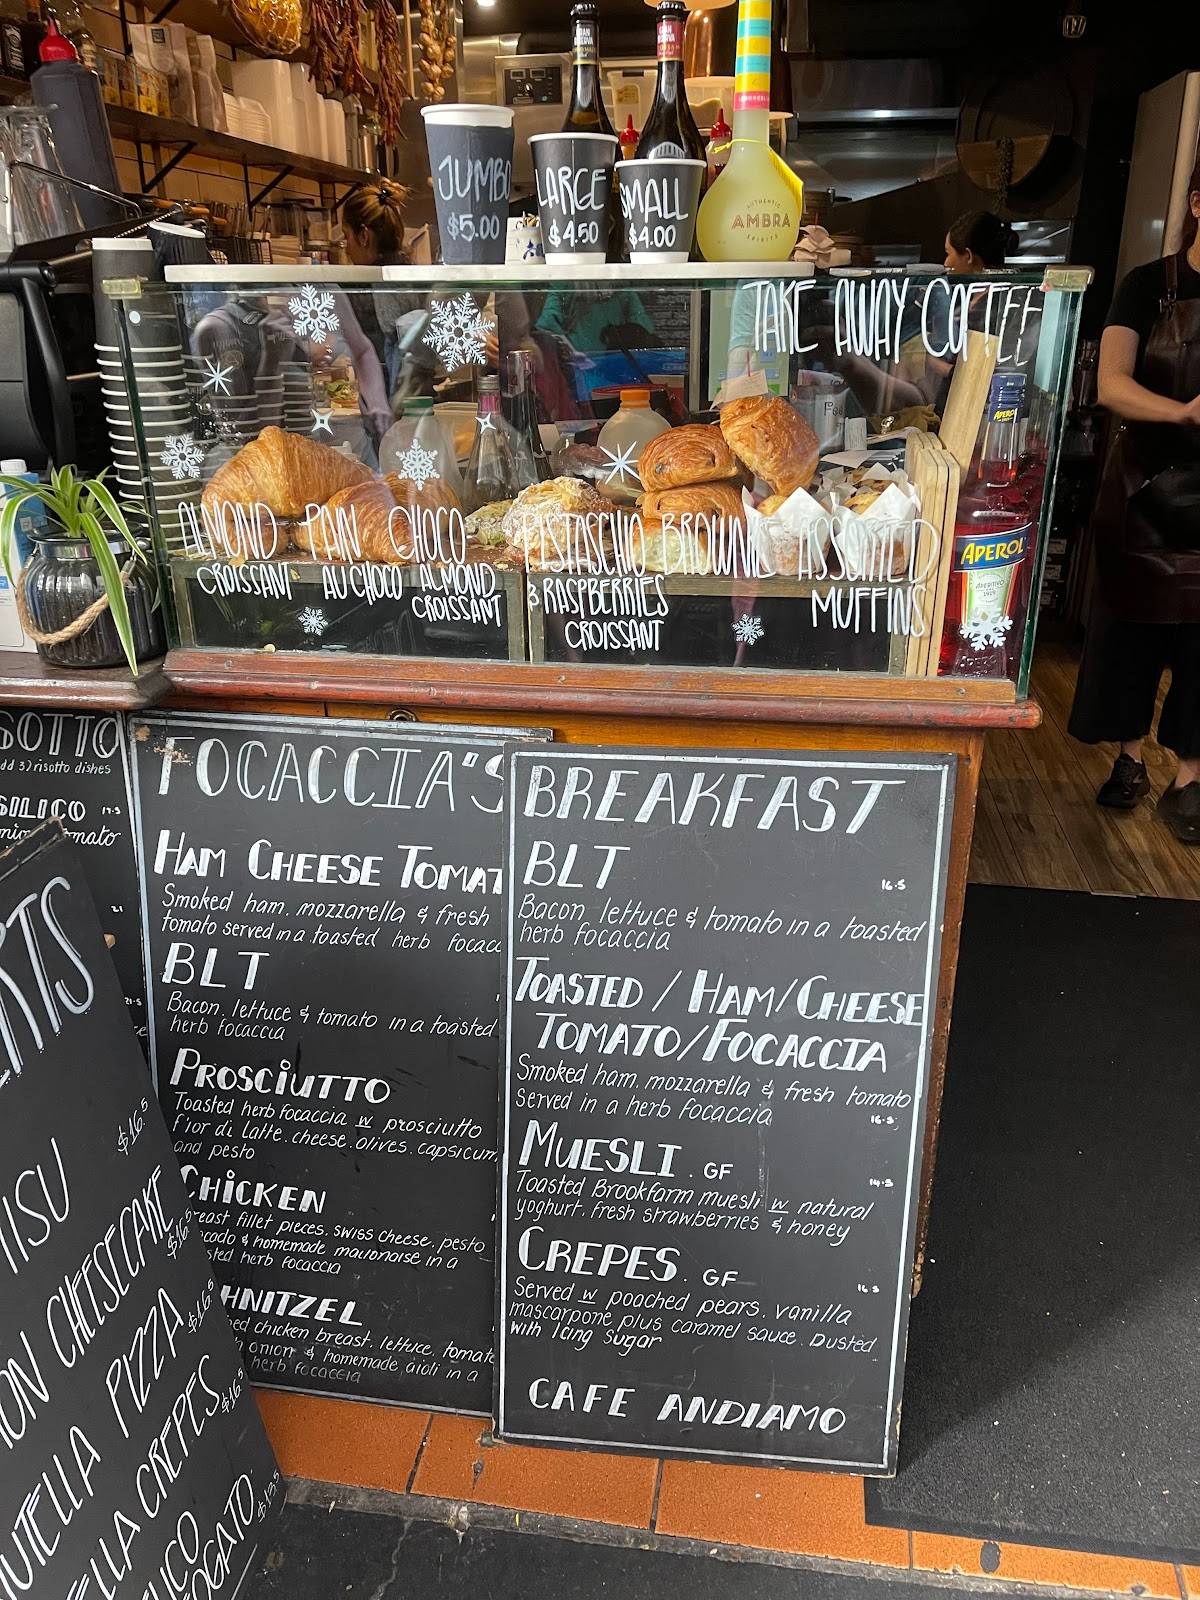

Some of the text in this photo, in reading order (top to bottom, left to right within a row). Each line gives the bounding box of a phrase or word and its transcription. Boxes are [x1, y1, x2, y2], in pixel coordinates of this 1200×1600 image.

[437, 154, 512, 204] JUMBO
[535, 164, 608, 217] LARGE
[618, 176, 689, 224] SMALL
[446, 211, 501, 242] $5.00
[548, 218, 600, 249] $4.50
[628, 221, 677, 251] $4.00
[731, 212, 791, 230] AMBRA
[742, 276, 1047, 367] TAKE AWAY COFFEE
[177, 499, 279, 561] ALMOND
[301, 503, 362, 564] PAN
[387, 503, 467, 566] CHOCO
[798, 518, 940, 584] ASSORTED
[959, 537, 1024, 566] APEROL
[196, 560, 293, 600] CROISSANT
[321, 560, 403, 606] AU CHOCO
[419, 563, 496, 599] ALMOND
[542, 574, 669, 619] RASPBERRIES
[411, 594, 502, 628] CROISSANT
[564, 618, 665, 651] CROISSANT
[810, 585, 928, 639] MUFFINS
[33, 759, 112, 775] risotto dishes
[522, 764, 907, 835] BREAKFAST
[152, 828, 228, 879] HAM
[247, 838, 385, 887] CHEESE
[522, 840, 632, 891] BLT
[162, 882, 233, 914] Smoked
[296, 901, 406, 924] mozzarella
[435, 908, 490, 928] fresh
[517, 892, 585, 921] Bacon
[599, 897, 678, 929] lettuce
[702, 905, 783, 936] tomato
[786, 919, 810, 938] in
[813, 921, 829, 939] a
[838, 916, 929, 945] toasted
[160, 911, 219, 936] tomato
[221, 921, 273, 942] served
[275, 927, 292, 942] in
[293, 930, 306, 943] a
[391, 931, 431, 951] herb
[518, 920, 672, 952] herb focaccia
[160, 942, 271, 990] BLT
[514, 955, 646, 1010] TOASTED
[168, 1015, 209, 1034] herb
[215, 1018, 287, 1042] focaccia
[230, 998, 292, 1022] lettuce
[316, 1006, 379, 1029] tomato
[388, 1015, 408, 1031] in
[409, 1019, 425, 1034] a
[430, 1016, 498, 1039] toasted
[534, 1011, 888, 1075] TOMATO/FOCACCIA
[168, 1046, 392, 1106] PROSCIUTTO
[516, 1053, 588, 1087] Smoked
[643, 1071, 752, 1099] mozzarella
[784, 1080, 836, 1105] fresh
[845, 1085, 912, 1109] tomato
[174, 1090, 236, 1116] Toasted
[239, 1097, 276, 1120] herb
[277, 1104, 349, 1128] focaccia
[381, 1115, 483, 1140] prosciutto
[214, 1119, 235, 1139] di
[515, 1087, 774, 1127] Served in a herb focaccia
[172, 1140, 256, 1162] and pesto
[518, 1119, 735, 1181] MUESLI GF
[179, 1165, 328, 1215] CHICKEN
[515, 1169, 586, 1197] Toasted
[591, 1178, 696, 1207] Brookfarm
[698, 1188, 762, 1211] muesli
[796, 1198, 876, 1222] natural
[235, 1211, 486, 1254] fillet swiss pesto
[590, 1203, 641, 1224] fresh
[642, 1207, 761, 1232] strawberries
[785, 1218, 852, 1247] honey
[240, 1250, 275, 1267] herb
[281, 1256, 342, 1275] focaccia
[253, 1235, 327, 1255] homemade
[425, 1252, 442, 1268] in
[446, 1255, 460, 1270] a
[517, 1226, 739, 1289] CREPES GF
[513, 1275, 573, 1302] Served
[604, 1290, 691, 1313] poached
[774, 1302, 853, 1326] vanilla
[254, 1320, 310, 1341] chicken
[507, 1300, 879, 1354] mascarpone plus caramel Dusted
[508, 1320, 663, 1358] with sugar
[105, 1287, 186, 1439] PIZZA
[250, 1356, 362, 1385] herb focaccia
[323, 1350, 400, 1373] homemade
[405, 1361, 441, 1378] aioli
[445, 1367, 462, 1382] in
[466, 1369, 480, 1384] a
[527, 1377, 848, 1436] CAFE ANDIAMO
[136, 1354, 222, 1519] CREPES
